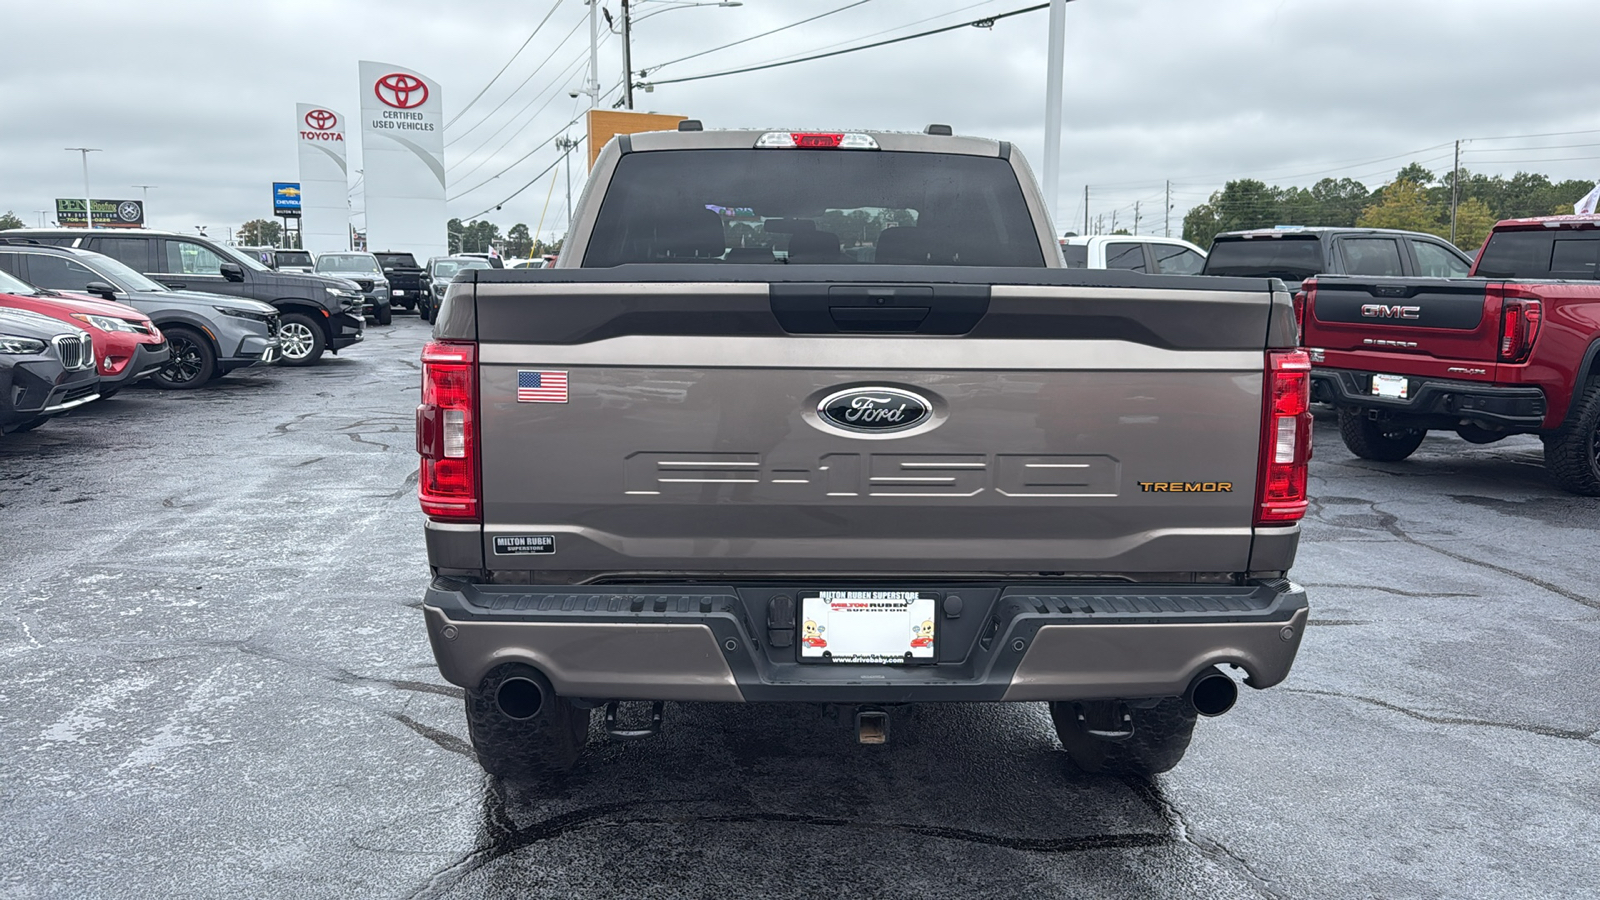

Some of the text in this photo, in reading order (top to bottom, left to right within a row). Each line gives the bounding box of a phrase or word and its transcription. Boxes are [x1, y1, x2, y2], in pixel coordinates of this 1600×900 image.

[383, 111, 423, 120] CERTIFIED
[372, 120, 434, 131] USED VEHICLES
[300, 131, 343, 141] TOYOTA
[1361, 304, 1420, 319] GMC
[1363, 338, 1418, 348] SIERRA
[845, 396, 906, 422] Ford
[624, 451, 1121, 498] F-150
[1139, 481, 1233, 492] TREMOR
[497, 537, 552, 546] MILTON RUBEN
[820, 591, 846, 599] MILTON
[847, 591, 871, 599] RUBEN
[832, 656, 904, 665] www.drivebaby.com
